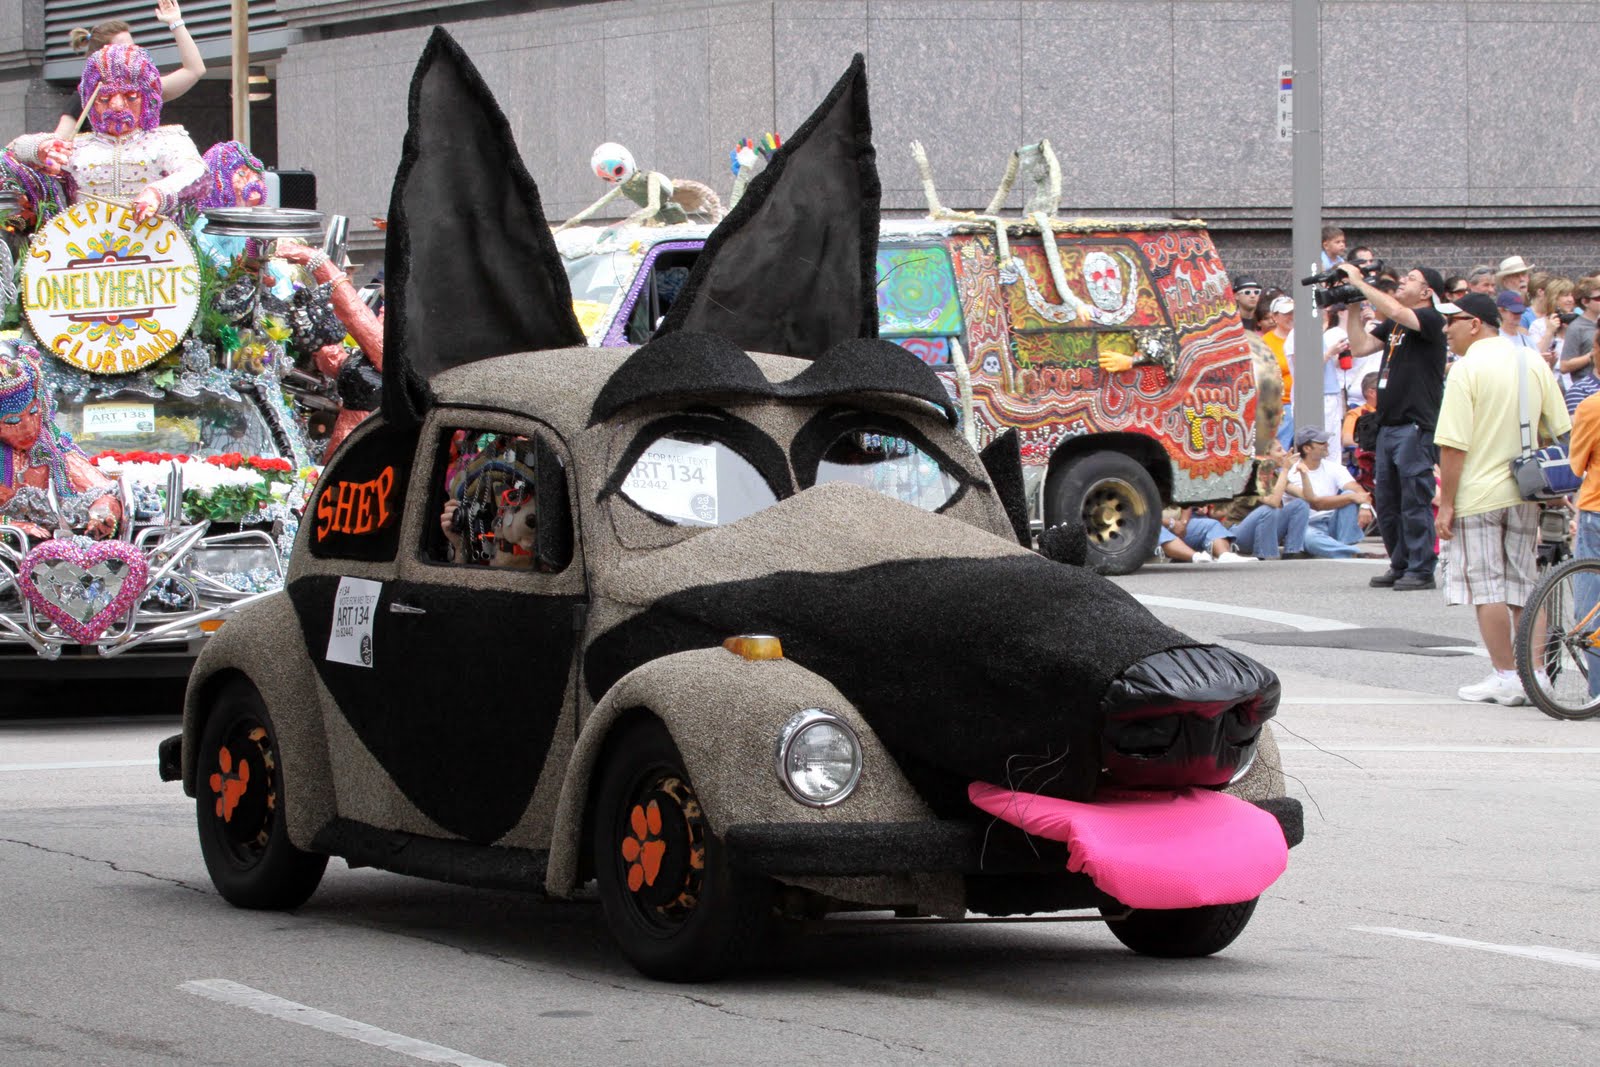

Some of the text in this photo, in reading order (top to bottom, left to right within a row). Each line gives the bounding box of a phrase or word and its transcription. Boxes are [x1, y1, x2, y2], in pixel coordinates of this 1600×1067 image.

[54, 201, 177, 254] PEPPERS
[52, 329, 178, 372] CLUB BAND
[91, 412, 118, 422] ART
[122, 411, 146, 419] 138
[648, 452, 666, 462] FOR
[668, 455, 684, 464] ME!
[688, 457, 709, 465] TEXT
[632, 479, 669, 490] 82442
[667, 463, 705, 485] 134
[317, 466, 394, 543] SHEP
[337, 606, 369, 627] ART 134
